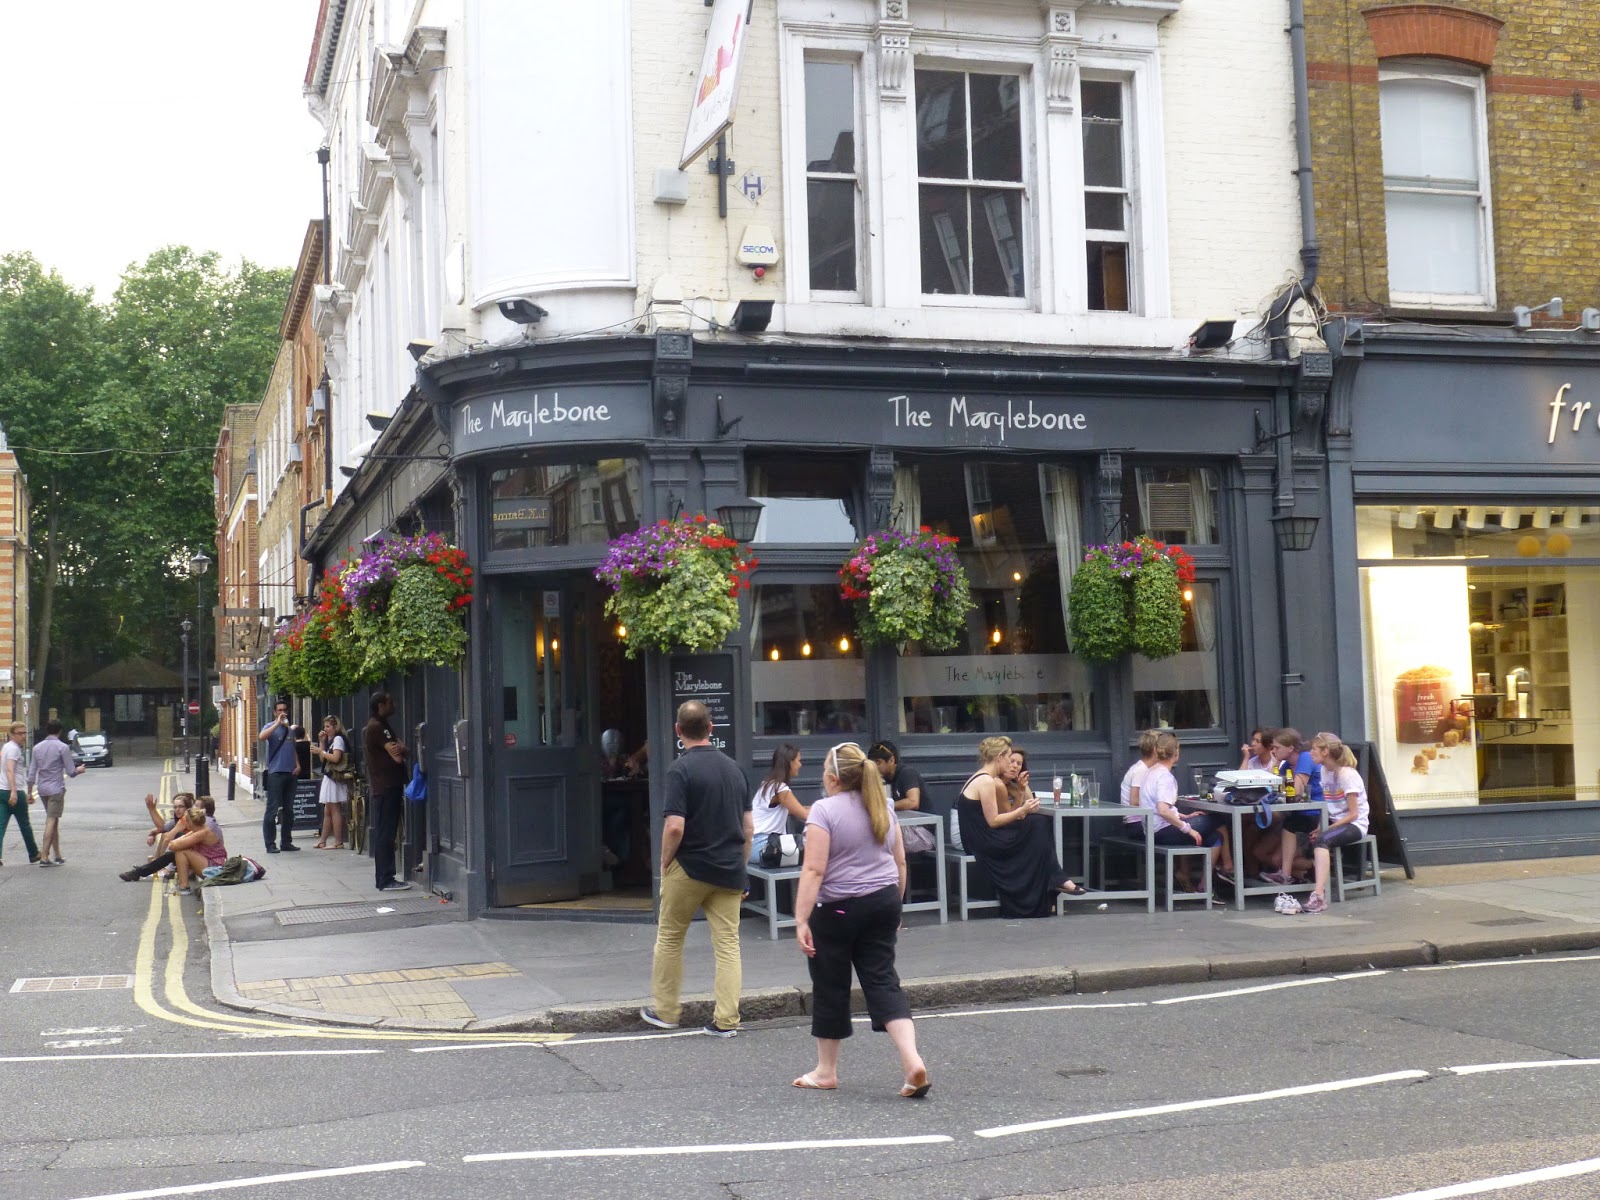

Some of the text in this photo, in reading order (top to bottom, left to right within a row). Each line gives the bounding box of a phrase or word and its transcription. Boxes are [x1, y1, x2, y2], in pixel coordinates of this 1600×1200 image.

[744, 176, 761, 195] H
[751, 191, 756, 200] 8
[743, 245, 774, 254] SECOM
[462, 392, 611, 437] The Marylebone
[888, 396, 1087, 441] The Marylebone
[1548, 383, 1600, 444] fr
[675, 672, 693, 680] The
[945, 666, 969, 681] The
[675, 680, 723, 692] Marylebone
[1417, 693, 1435, 702] fresh
